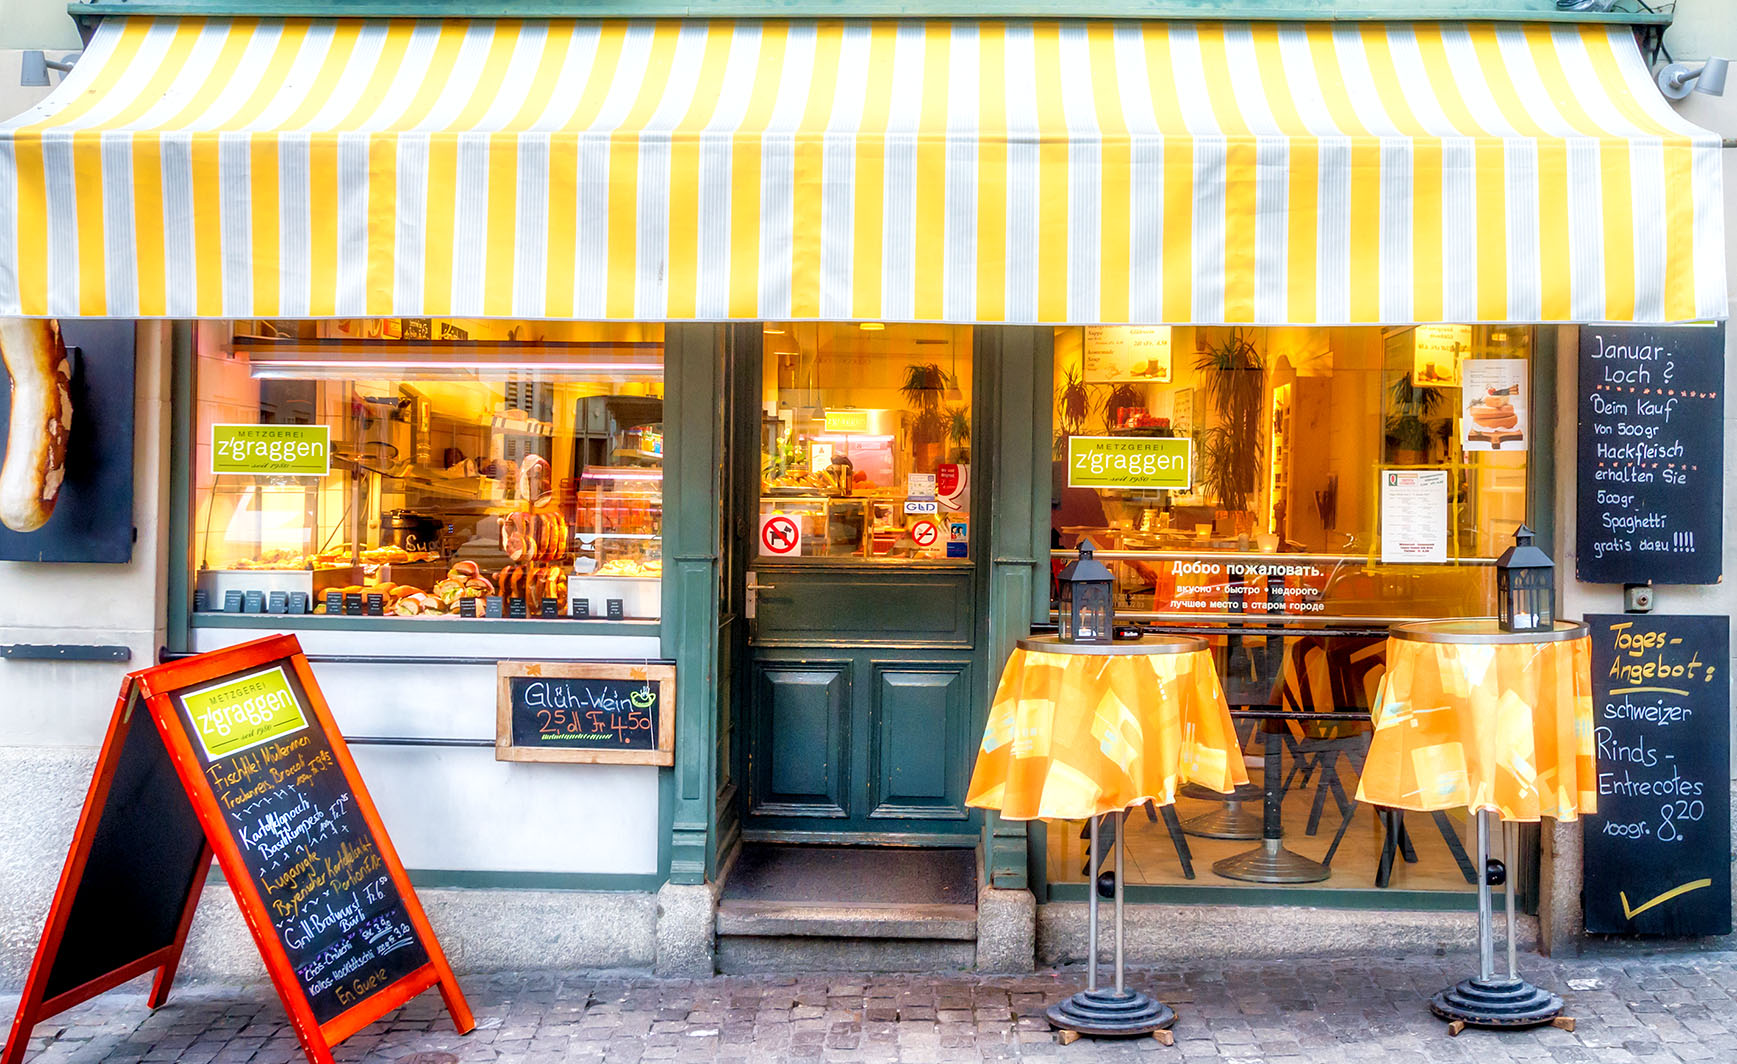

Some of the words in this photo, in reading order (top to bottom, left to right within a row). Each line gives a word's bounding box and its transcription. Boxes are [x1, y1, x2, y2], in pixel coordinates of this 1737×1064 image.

[1604, 363, 1650, 384] Loch
[1096, 443, 1164, 451] METZGEREI
[1596, 439, 1684, 465] Hackfleisch
[1594, 467, 1654, 484] erhalten
[1662, 469, 1686, 485] Sie
[1596, 490, 1635, 508] 500gr
[1602, 512, 1667, 534] Spaghetti
[1593, 539, 1632, 559] gratis
[1224, 584, 1260, 596] быстро
[1271, 586, 1319, 597] недорого
[1170, 600, 1207, 610] лучшее
[1209, 600, 1239, 609] место
[1251, 601, 1286, 611] старом
[1289, 602, 1325, 612] городе
[208, 682, 267, 705] METZGEREI
